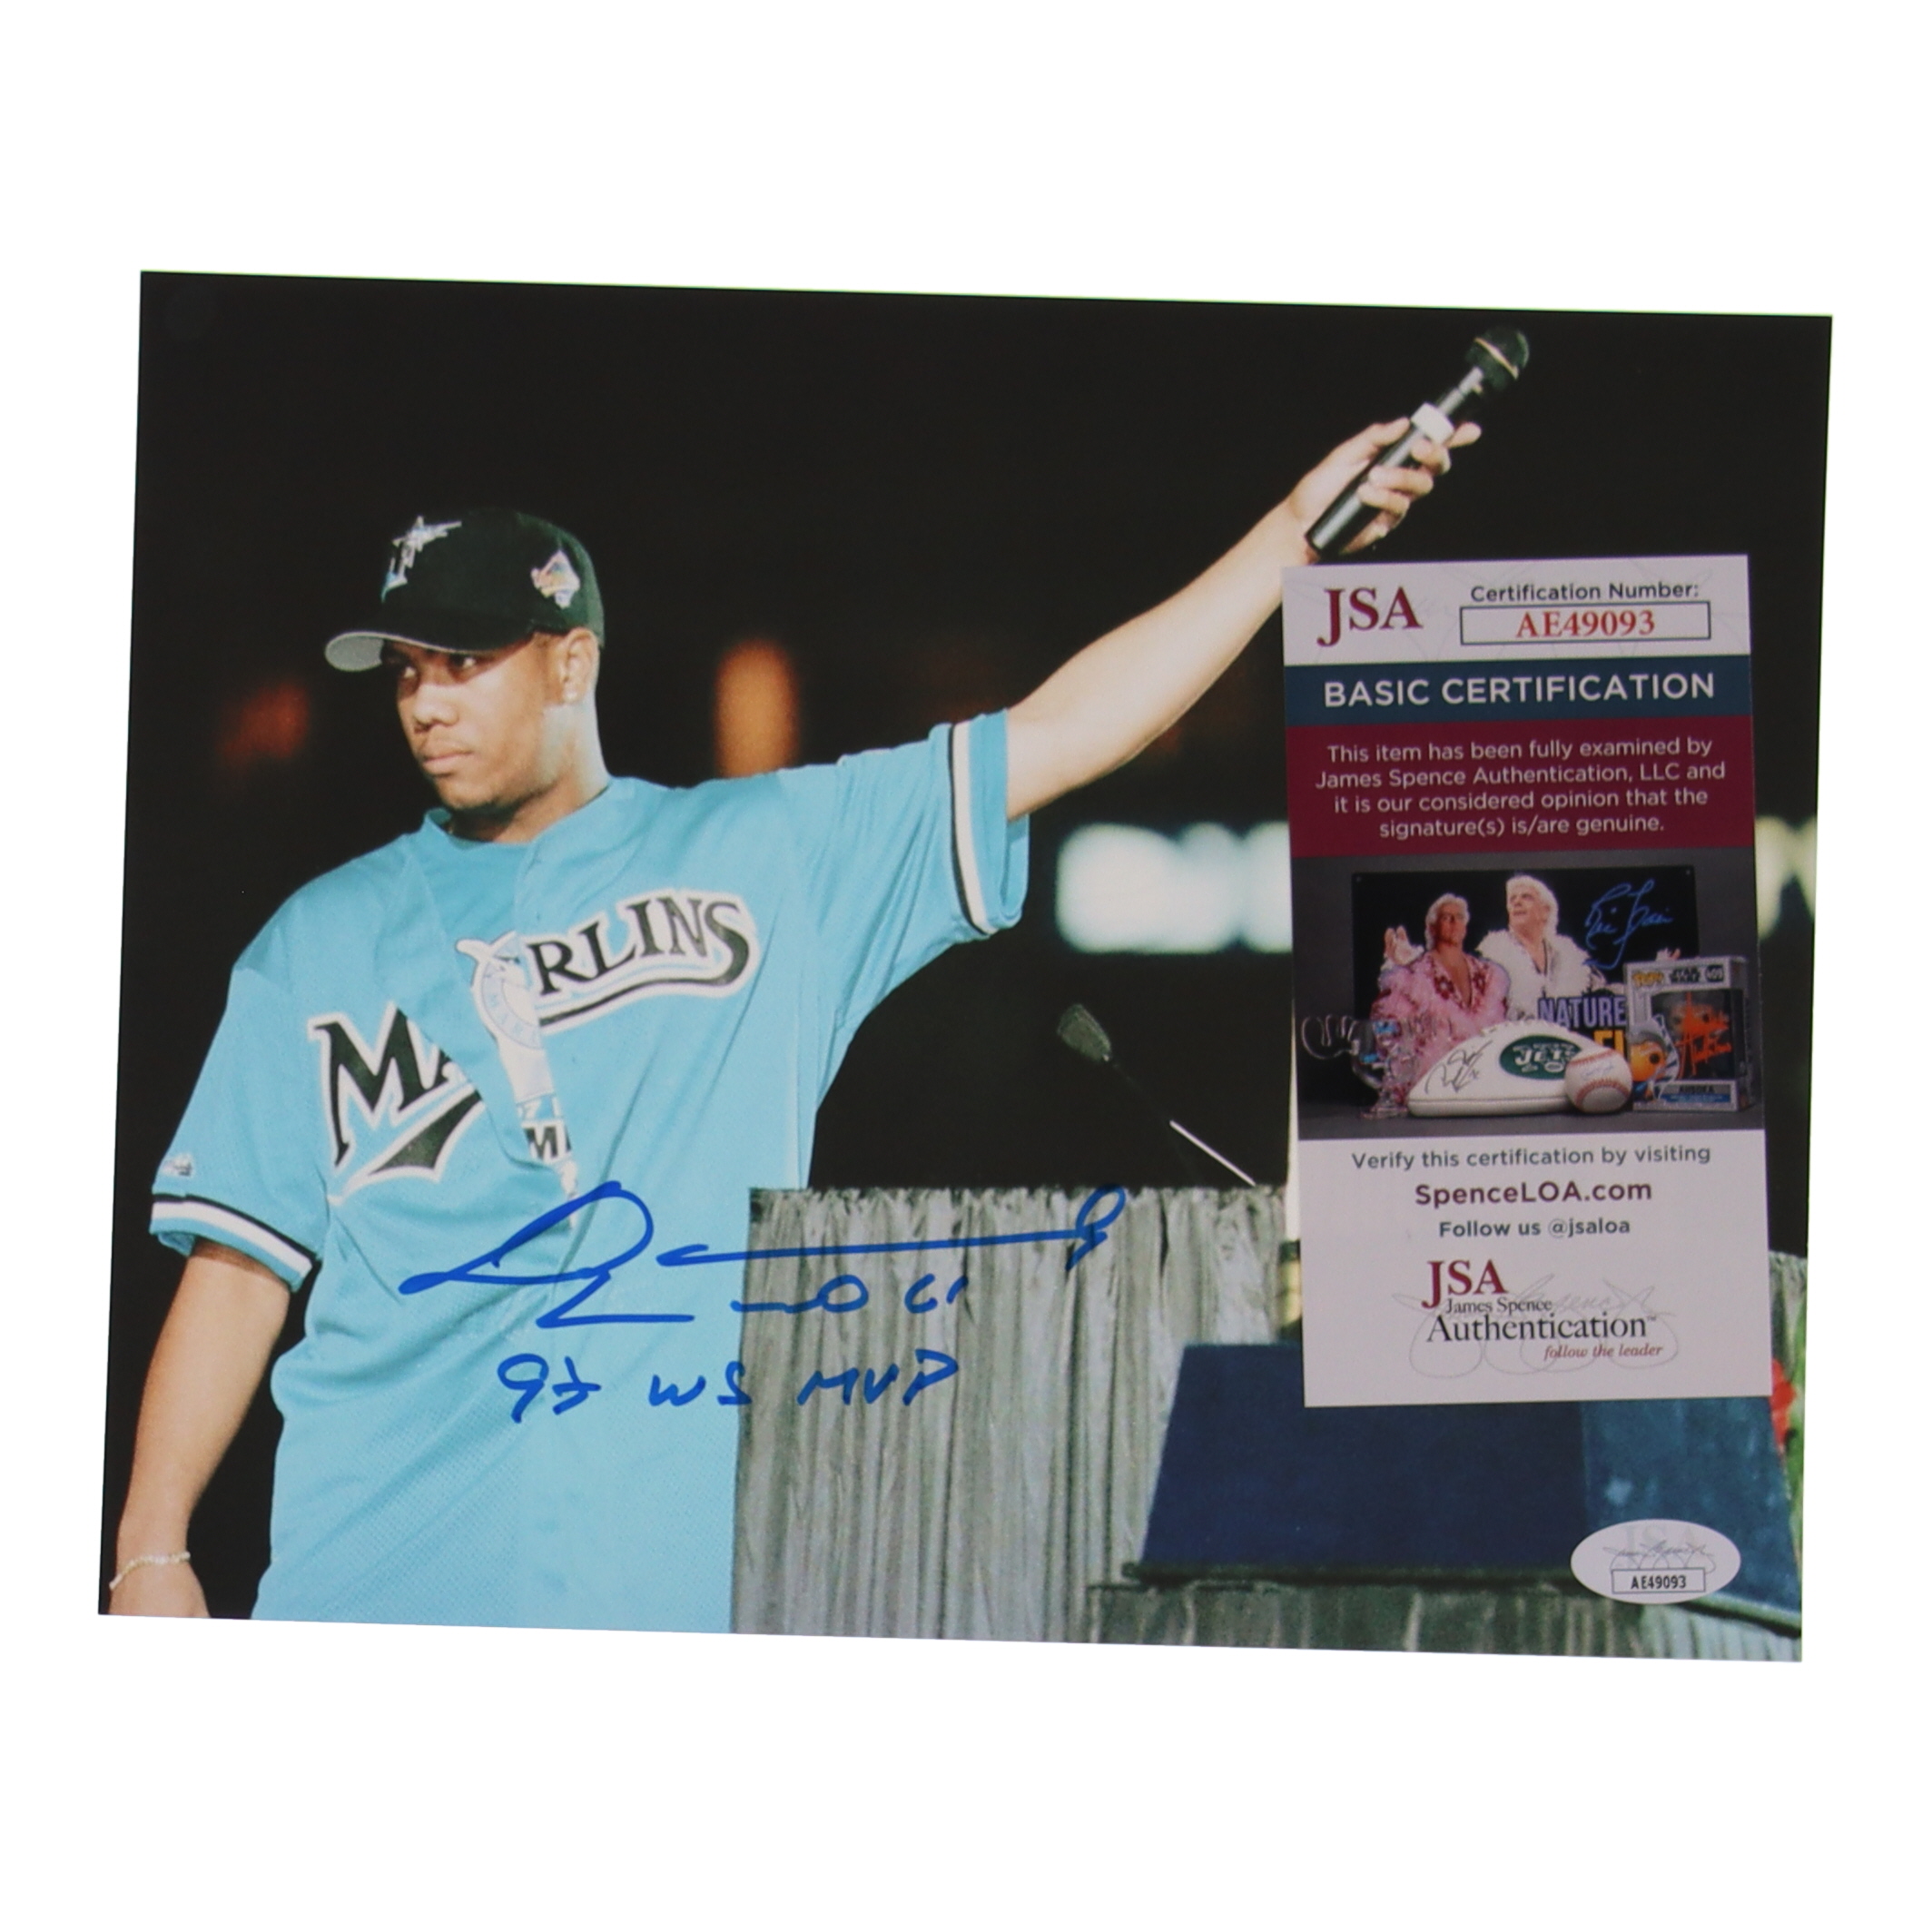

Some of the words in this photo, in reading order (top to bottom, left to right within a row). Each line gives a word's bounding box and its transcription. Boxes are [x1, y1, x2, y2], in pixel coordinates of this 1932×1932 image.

[1471, 583, 1601, 602] Certification
[1610, 581, 1699, 599] Number:
[1316, 586, 1424, 646] JSA
[1516, 609, 1655, 637] AE49093
[1325, 679, 1430, 707] BASIC
[1442, 673, 1714, 705] CERTIFICATION
[1327, 744, 1369, 763] This
[1376, 744, 1421, 762] item
[1429, 742, 1464, 760] has
[1471, 741, 1522, 759] been
[1529, 739, 1572, 760] fully
[1580, 736, 1680, 755] examined
[1687, 735, 1712, 757] by
[1315, 771, 1382, 789] James
[1388, 769, 1466, 789] Spence
[1473, 764, 1633, 784] Authentication,
[1640, 762, 1680, 781] LLC
[1687, 761, 1725, 780] and
[1334, 795, 1348, 813] it
[1355, 795, 1371, 813] is
[1377, 797, 1412, 812] our
[1419, 791, 1534, 811] considered
[1541, 790, 1619, 811] opinion
[1626, 788, 1668, 806] that
[1674, 786, 1709, 805] the
[1379, 818, 1505, 840] signature(s)
[1512, 814, 1570, 837] is/are
[1576, 813, 1664, 836] genuine.
[1538, 996, 1628, 1029] NATURE
[1352, 1151, 1414, 1171] Verify
[1422, 1150, 1459, 1168] this
[1466, 1148, 1593, 1167] certification
[1602, 1147, 1626, 1166] by
[1634, 1145, 1710, 1164] visiting
[1415, 1180, 1651, 1209] SpenceLOA.com
[1439, 1220, 1511, 1237] Follow
[1518, 1222, 1541, 1236] us
[1548, 1217, 1631, 1238] @jsaloa
[1421, 1259, 1509, 1309] JSA
[1445, 1298, 1493, 1314] James
[1497, 1296, 1552, 1316] Spence
[1425, 1311, 1646, 1342] Authentication
[1543, 1345, 1587, 1360] follow
[1592, 1344, 1613, 1357] the
[1618, 1343, 1663, 1357] leader
[796, 1349, 959, 1407] MVP
[1631, 1575, 1687, 1590] AE49093
